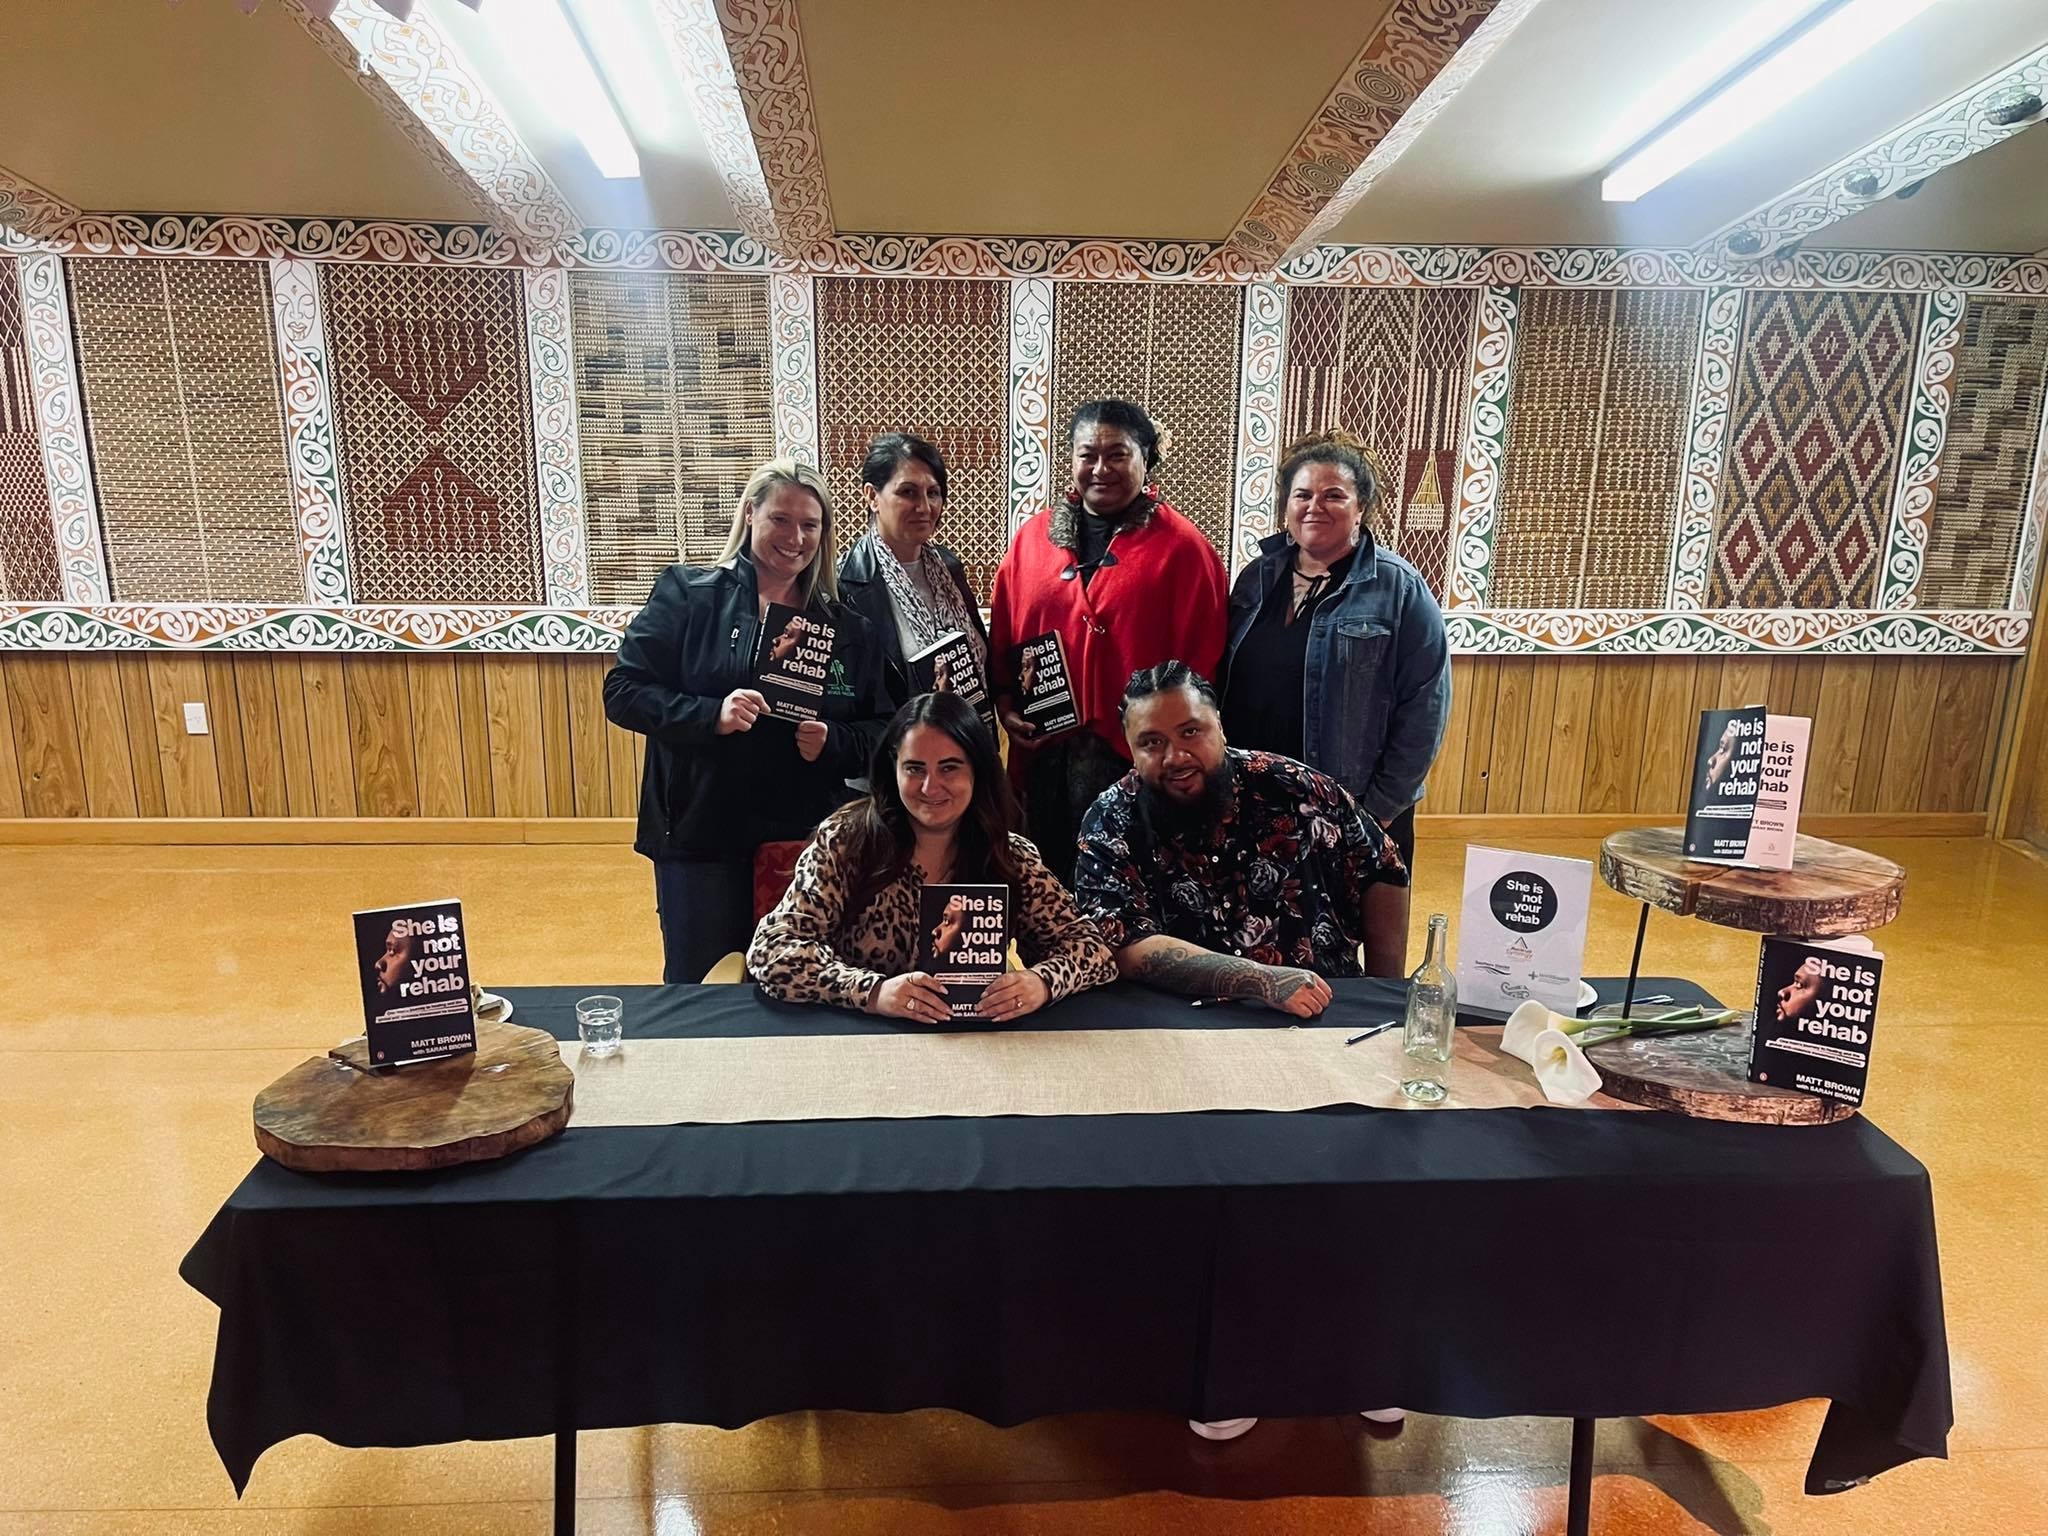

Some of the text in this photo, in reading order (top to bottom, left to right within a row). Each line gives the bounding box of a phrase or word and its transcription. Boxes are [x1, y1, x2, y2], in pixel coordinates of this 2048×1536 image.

[792, 616, 835, 638] She is
[807, 636, 833, 652] not
[1023, 640, 1056, 659] She is
[795, 647, 830, 664] your
[935, 643, 968, 666] She is
[952, 653, 972, 671] not
[1040, 651, 1060, 666] not
[782, 660, 826, 679] rehab
[949, 665, 974, 687] your
[1036, 663, 1062, 682] your
[953, 677, 979, 696] ehab
[1033, 676, 1066, 696] rehab
[777, 701, 817, 716] MATT BROWN
[1728, 718, 1764, 736] She is
[1740, 738, 1762, 755] not
[1781, 741, 1795, 753] is
[1730, 758, 1760, 778] your
[1767, 754, 1793, 766] not
[1762, 767, 1791, 778] our
[1718, 778, 1757, 796] rehab
[1760, 779, 1789, 793] hab
[1506, 880, 1543, 894] She is
[950, 895, 1003, 911] She is
[1514, 902, 1542, 914] your
[1522, 894, 1542, 904] not
[973, 914, 1003, 928] not
[1505, 912, 1540, 925] rehab
[392, 918, 436, 938] She
[423, 933, 461, 954] not
[961, 932, 1002, 948] your
[949, 949, 1002, 964] rehab
[411, 954, 462, 978] your
[1805, 956, 1876, 986] She is
[400, 973, 464, 997] rehab
[1832, 985, 1873, 1005] not
[1816, 1000, 1872, 1023] your
[1798, 1018, 1868, 1044] rehab
[411, 1033, 471, 1048] MATT BROWN
[426, 1045, 448, 1053] SARAH
[449, 1042, 472, 1050] BROWN
[1796, 1074, 1860, 1096] MATT BROWN
[1810, 1086, 1833, 1096] SARAH
[1834, 1092, 1859, 1102] BROWN
